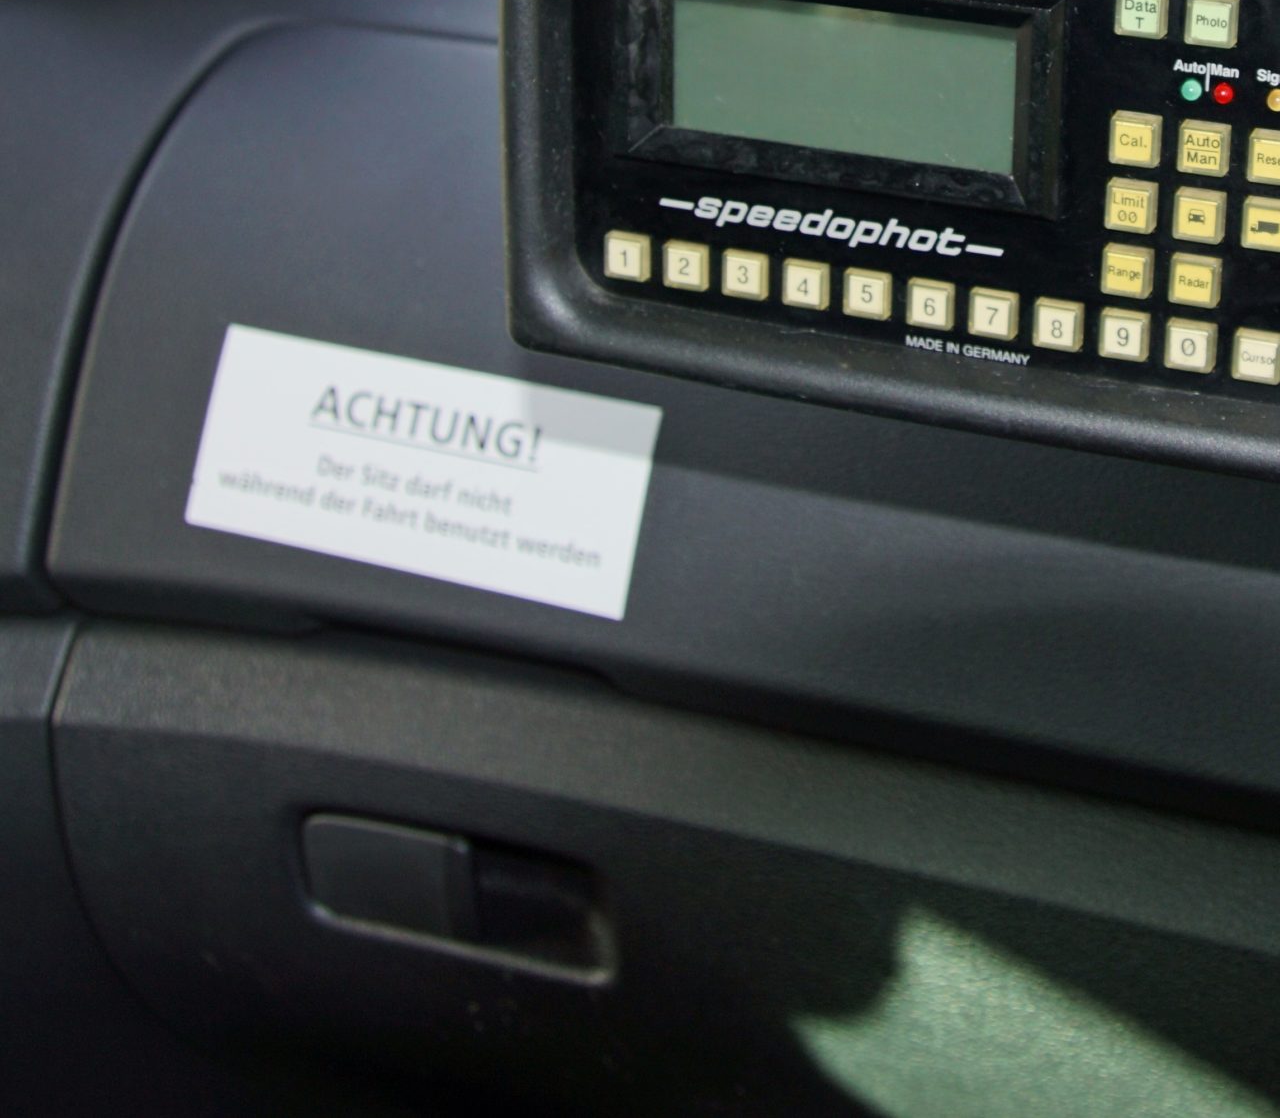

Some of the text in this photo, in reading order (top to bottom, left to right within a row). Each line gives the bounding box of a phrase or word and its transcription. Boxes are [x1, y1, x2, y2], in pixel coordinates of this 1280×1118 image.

[1135, 17, 1145, 30] T
[1196, 14, 1228, 29] Photo
[1119, 134, 1148, 148] Cal.
[1185, 134, 1220, 149] Auto
[1186, 153, 1218, 166] Man
[1113, 194, 1145, 209] Limit
[1108, 264, 1141, 282] Range
[1179, 274, 1210, 290] Radar
[619, 250, 1196, 357] 1 2 3 4 5 6 7 8 9 0
[905, 335, 1030, 366] MADE IN GERMANY
[310, 384, 545, 465] ACHTUNG!
[316, 453, 512, 515] Der Sitz darf nicht
[319, 485, 356, 515] der
[361, 495, 419, 532] Fahrt
[424, 510, 511, 550] benutzt
[515, 529, 602, 570] werden
